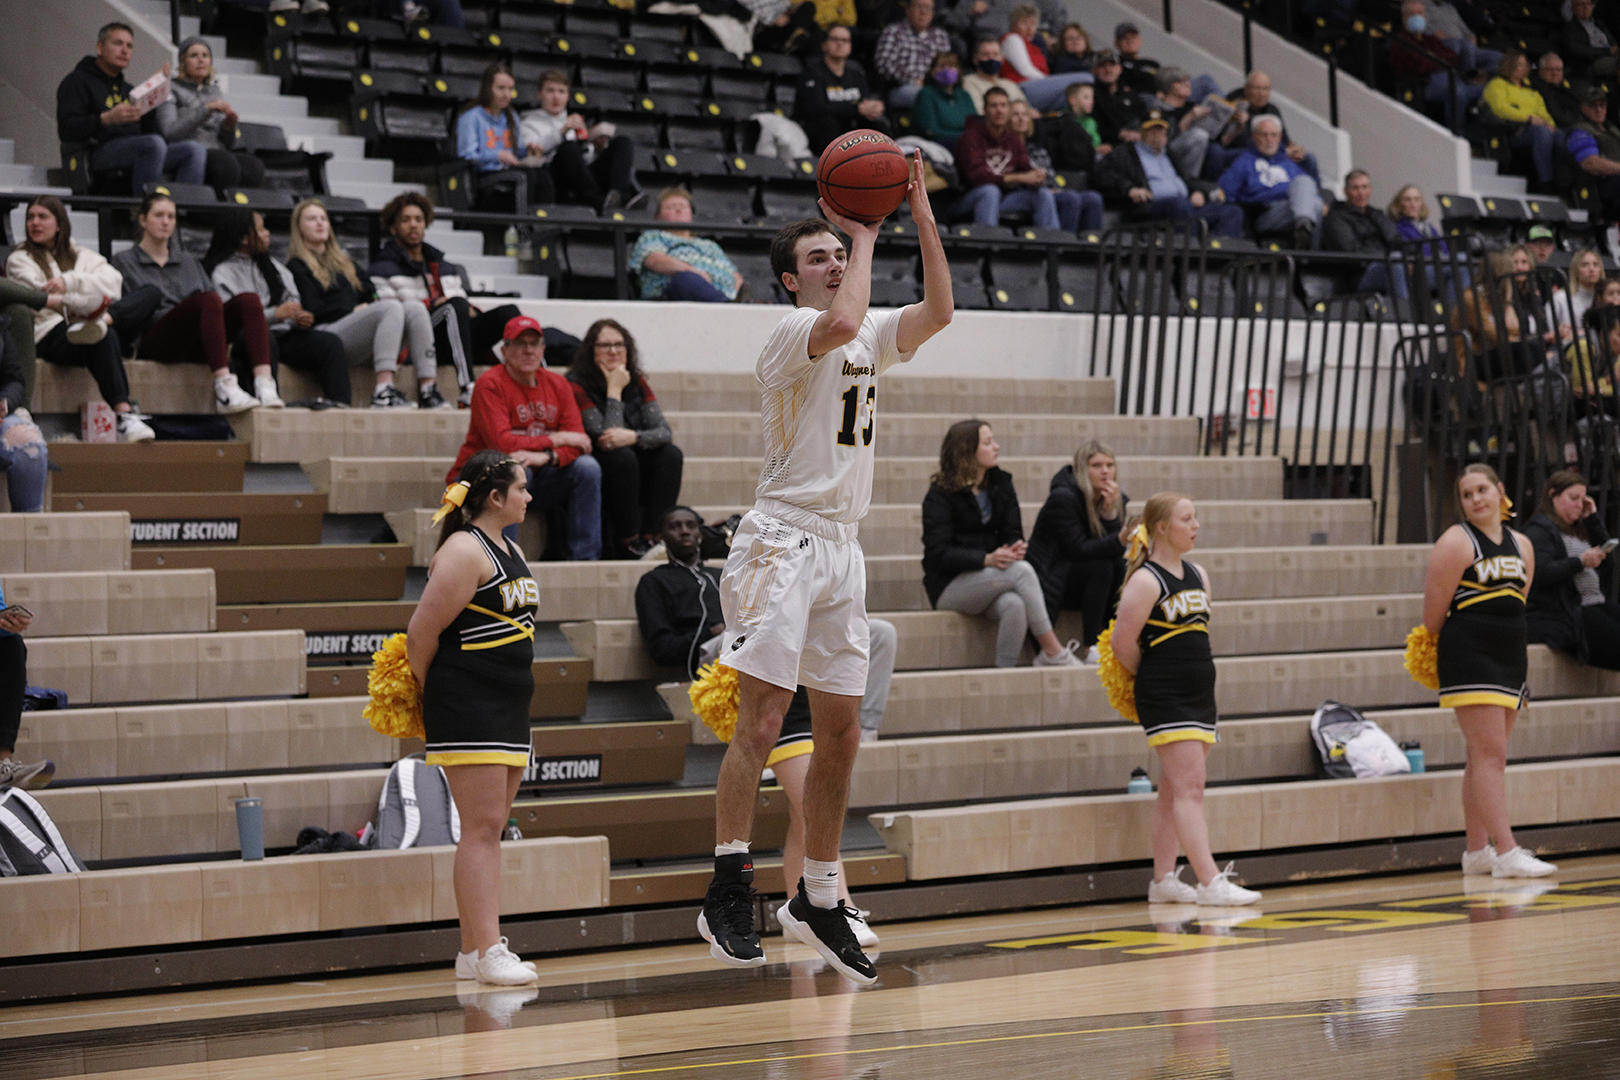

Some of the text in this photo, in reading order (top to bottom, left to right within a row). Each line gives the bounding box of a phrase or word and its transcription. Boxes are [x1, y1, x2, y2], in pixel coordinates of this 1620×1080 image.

[130, 521, 238, 541] TUDENT SECTION
[499, 577, 541, 612] WS
[305, 634, 395, 655] UDENT SECT
[541, 759, 600, 781] SECTION
